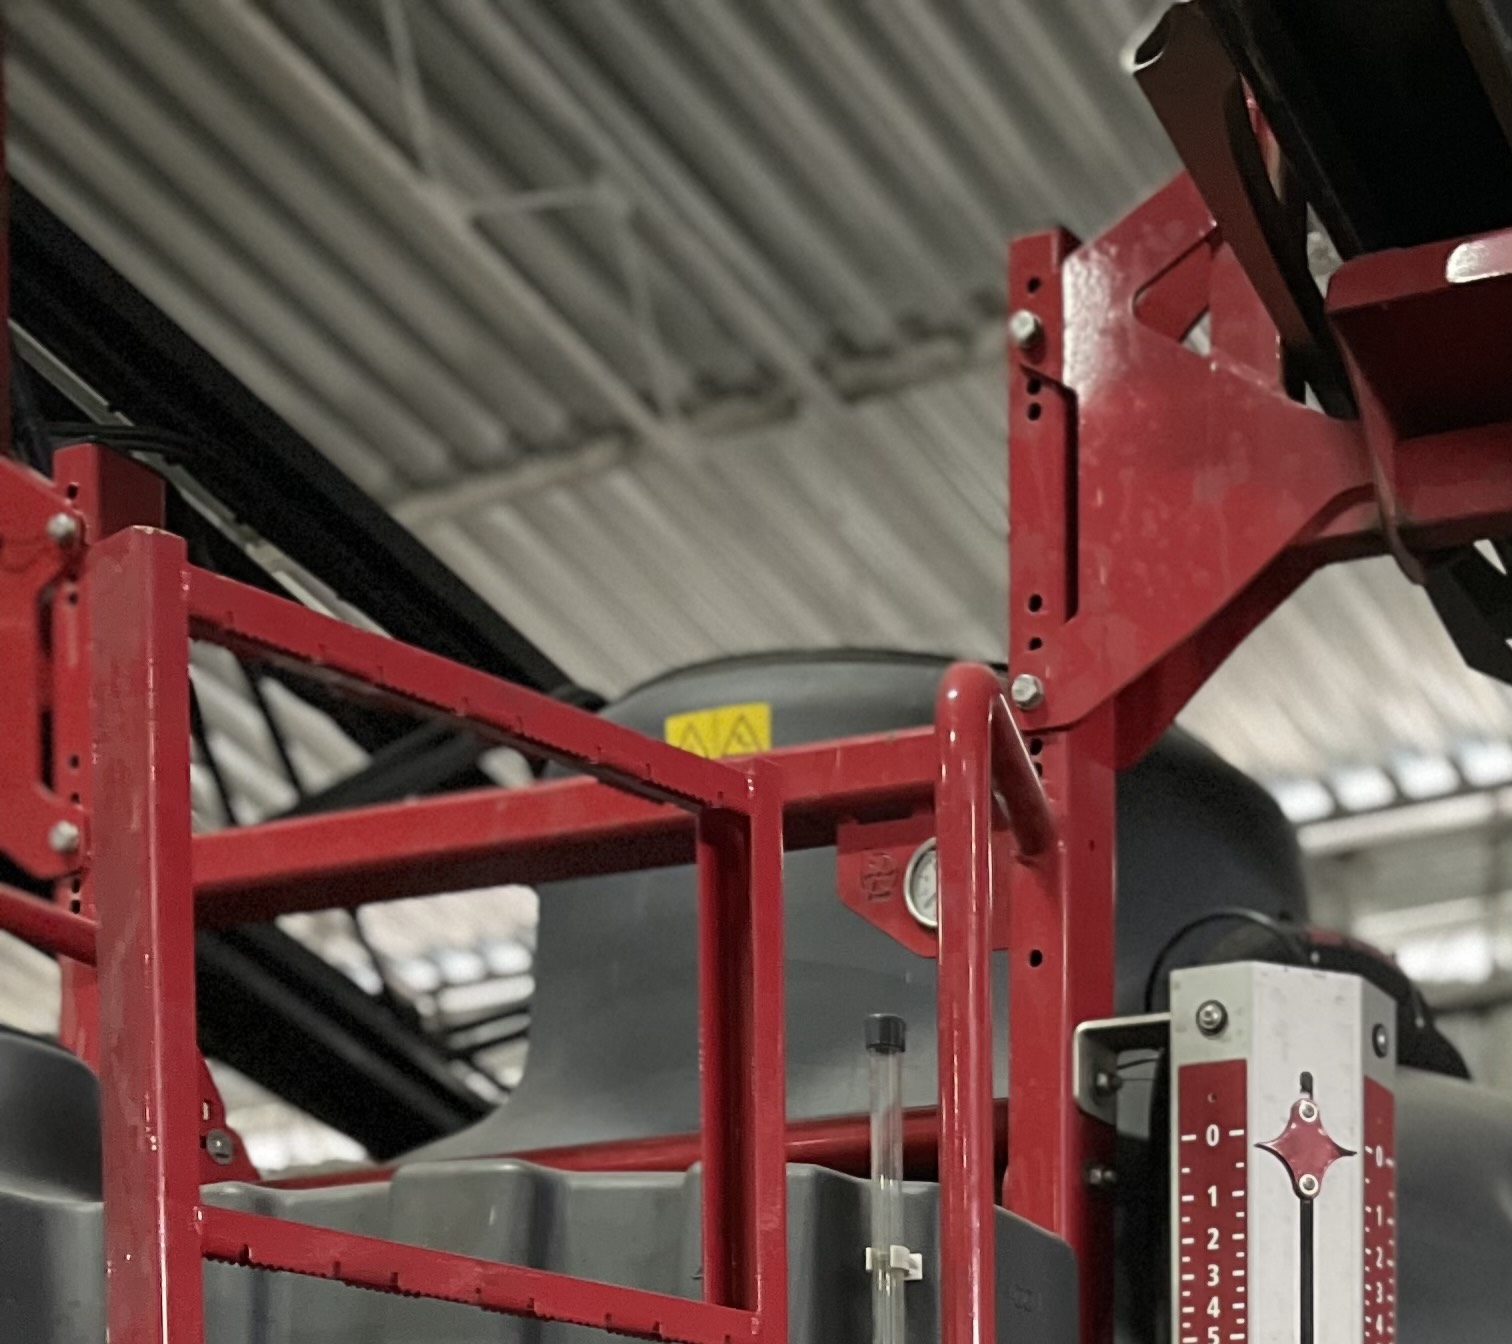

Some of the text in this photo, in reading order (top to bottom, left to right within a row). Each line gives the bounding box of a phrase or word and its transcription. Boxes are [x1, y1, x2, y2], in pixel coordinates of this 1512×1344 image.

[1205, 1124, 1220, 1147] 0
[1375, 1145, 1384, 1168] 0
[1207, 1185, 1217, 1207] 1
[1375, 1204, 1383, 1227] 1
[1207, 1227, 1220, 1251] 2
[1375, 1246, 1384, 1269] 2
[1207, 1264, 1220, 1287] 3
[1375, 1281, 1384, 1304] 3
[1206, 1295, 1221, 1319] 4
[1375, 1314, 1384, 1335] 4
